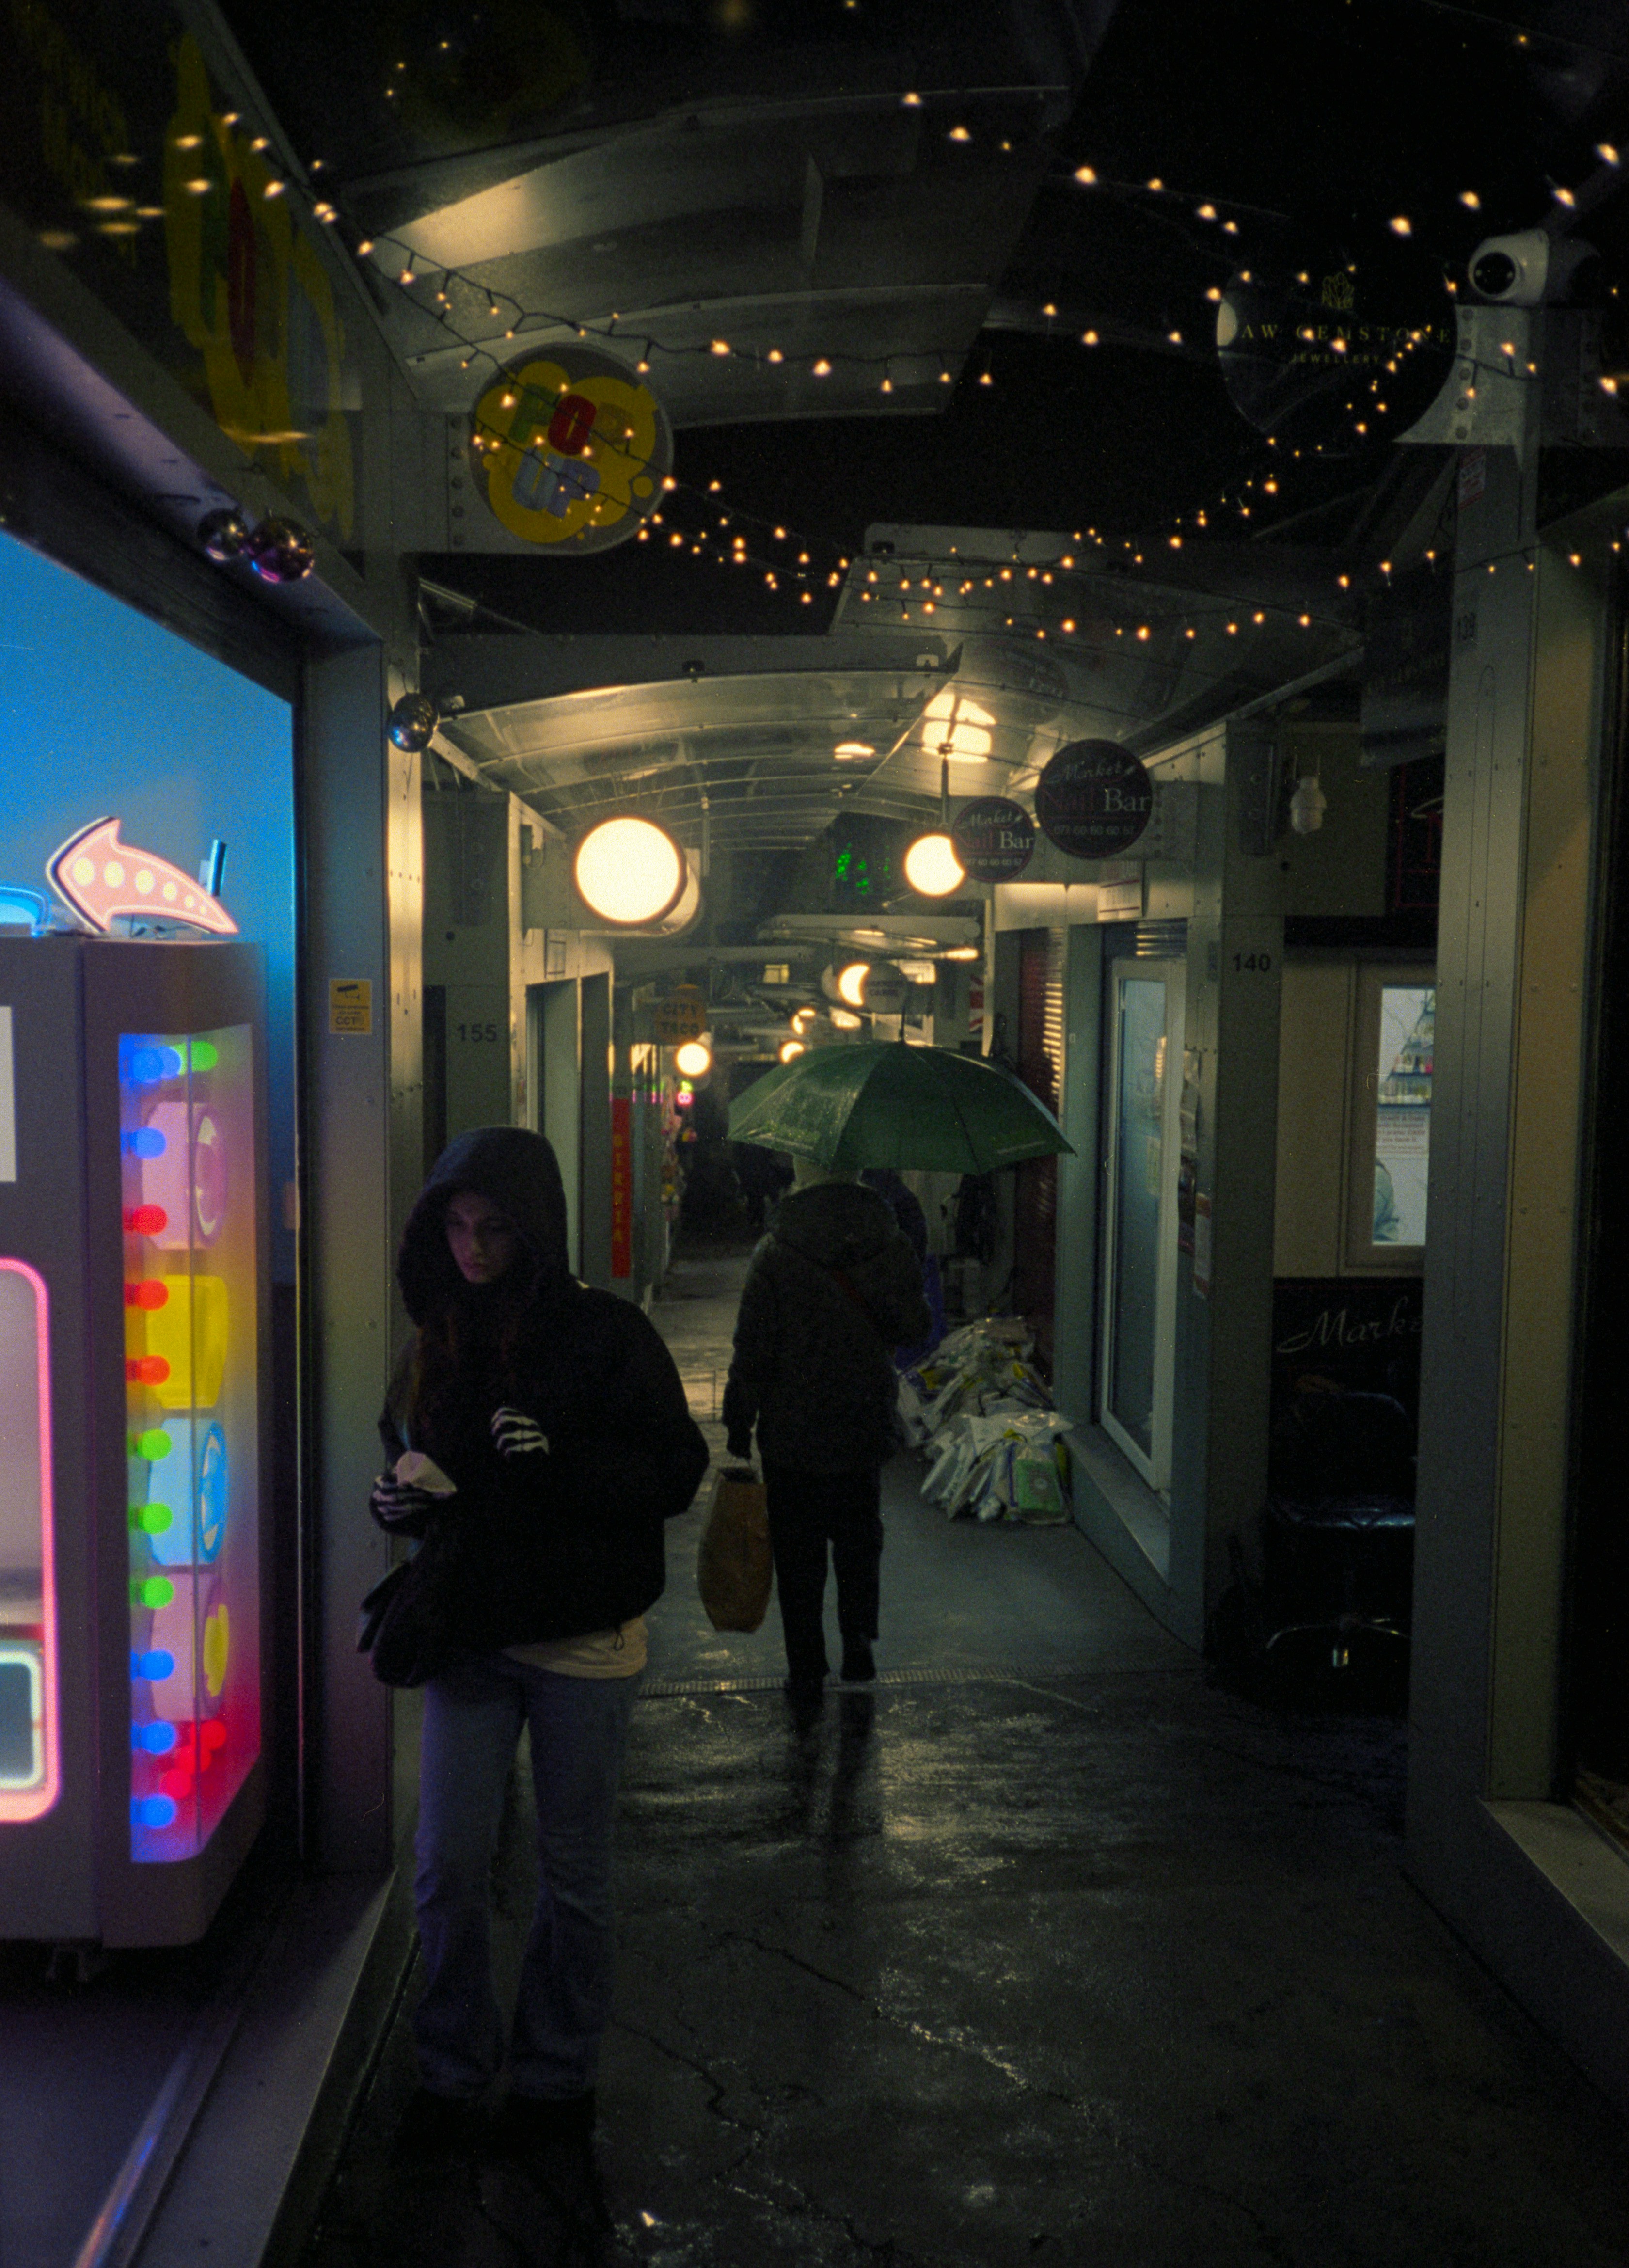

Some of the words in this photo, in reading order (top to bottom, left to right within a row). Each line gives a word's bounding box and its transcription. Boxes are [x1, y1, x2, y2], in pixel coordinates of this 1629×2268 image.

[1291, 353, 1380, 365] JEWELLERY
[510, 446, 601, 520] UP
[1041, 786, 1094, 811] Nail
[1104, 788, 1151, 812] Bar
[999, 830, 1034, 849] Bar
[1233, 953, 1271, 972] 140
[662, 1003, 699, 1017] CITY
[458, 1023, 497, 1042] 155
[660, 1021, 699, 1036] TACO
